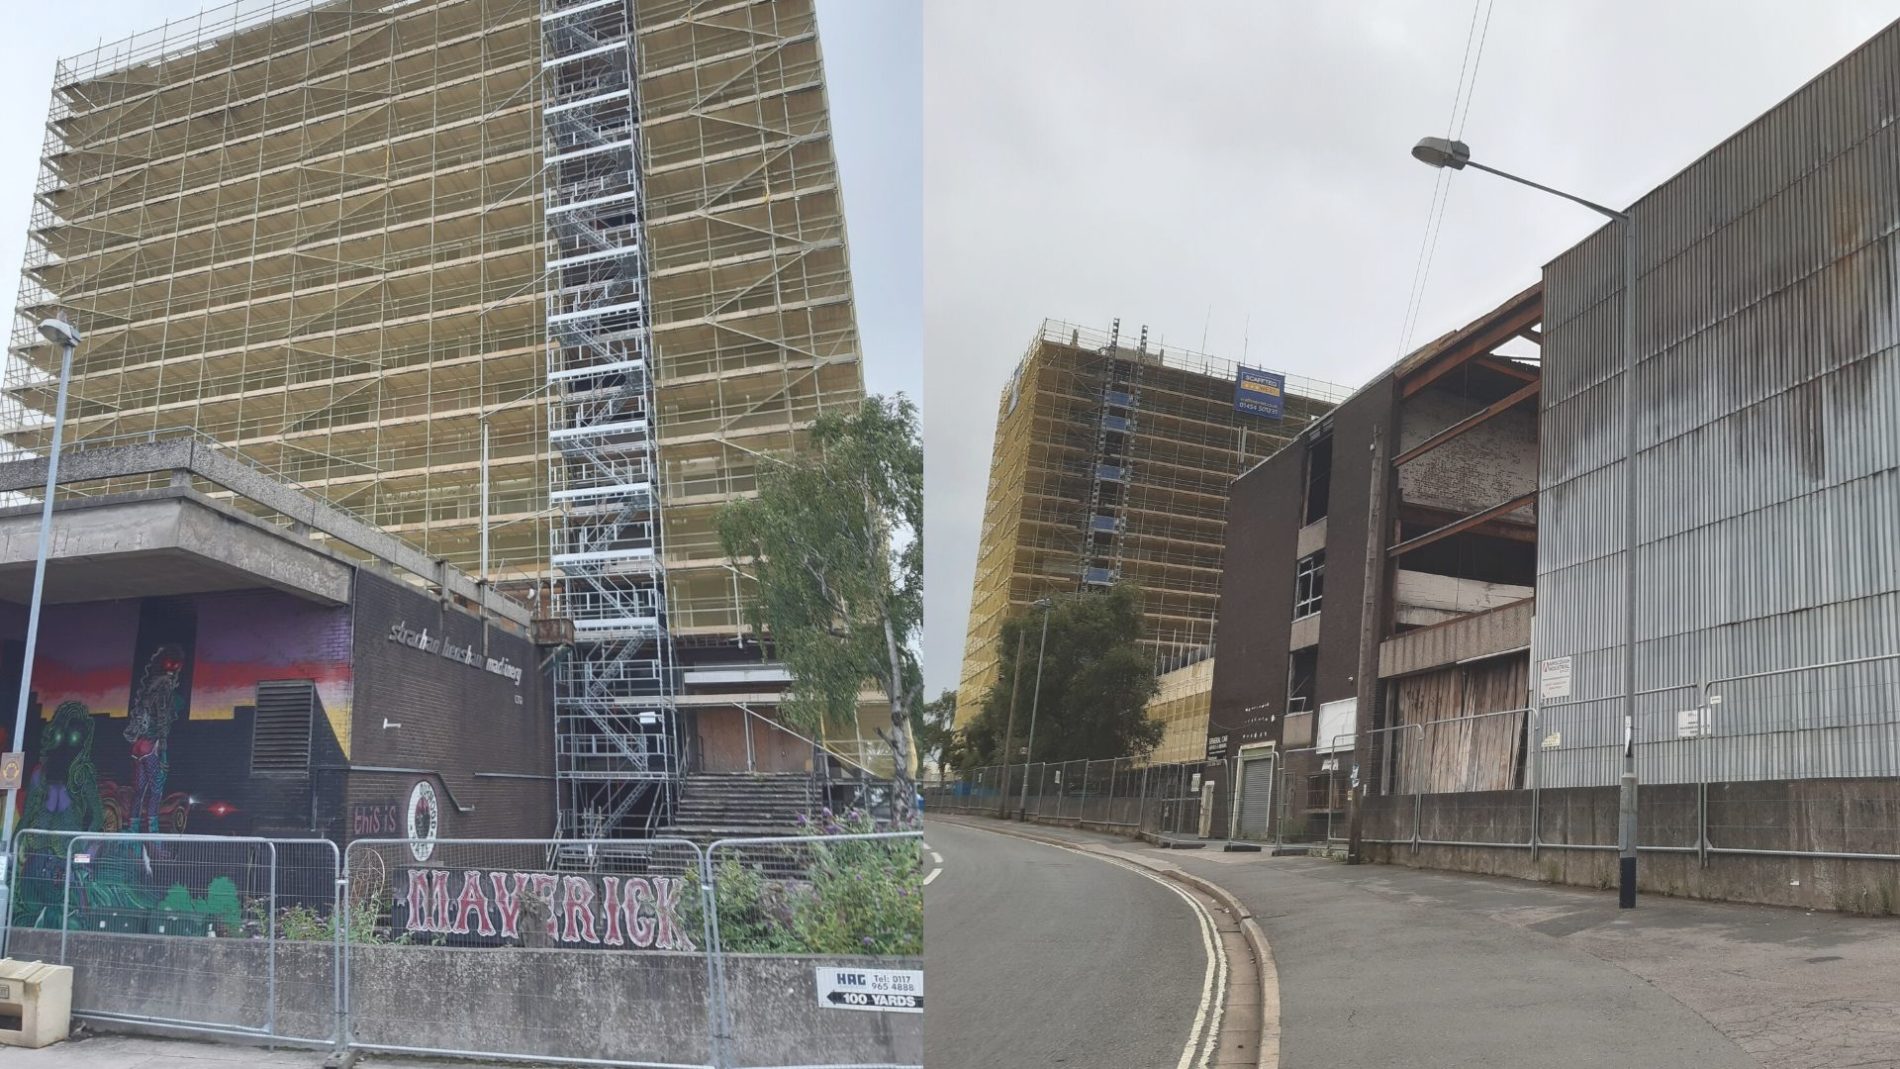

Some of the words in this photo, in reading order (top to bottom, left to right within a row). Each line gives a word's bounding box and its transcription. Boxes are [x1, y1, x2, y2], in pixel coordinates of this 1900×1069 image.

[836, 973, 866, 986] HAG
[873, 974, 890, 983] Tel:
[892, 975, 911, 984] 0117
[871, 982, 889, 991] 965
[891, 983, 914, 992] 4888
[843, 993, 868, 1004] 100
[871, 994, 916, 1007] YARDS
